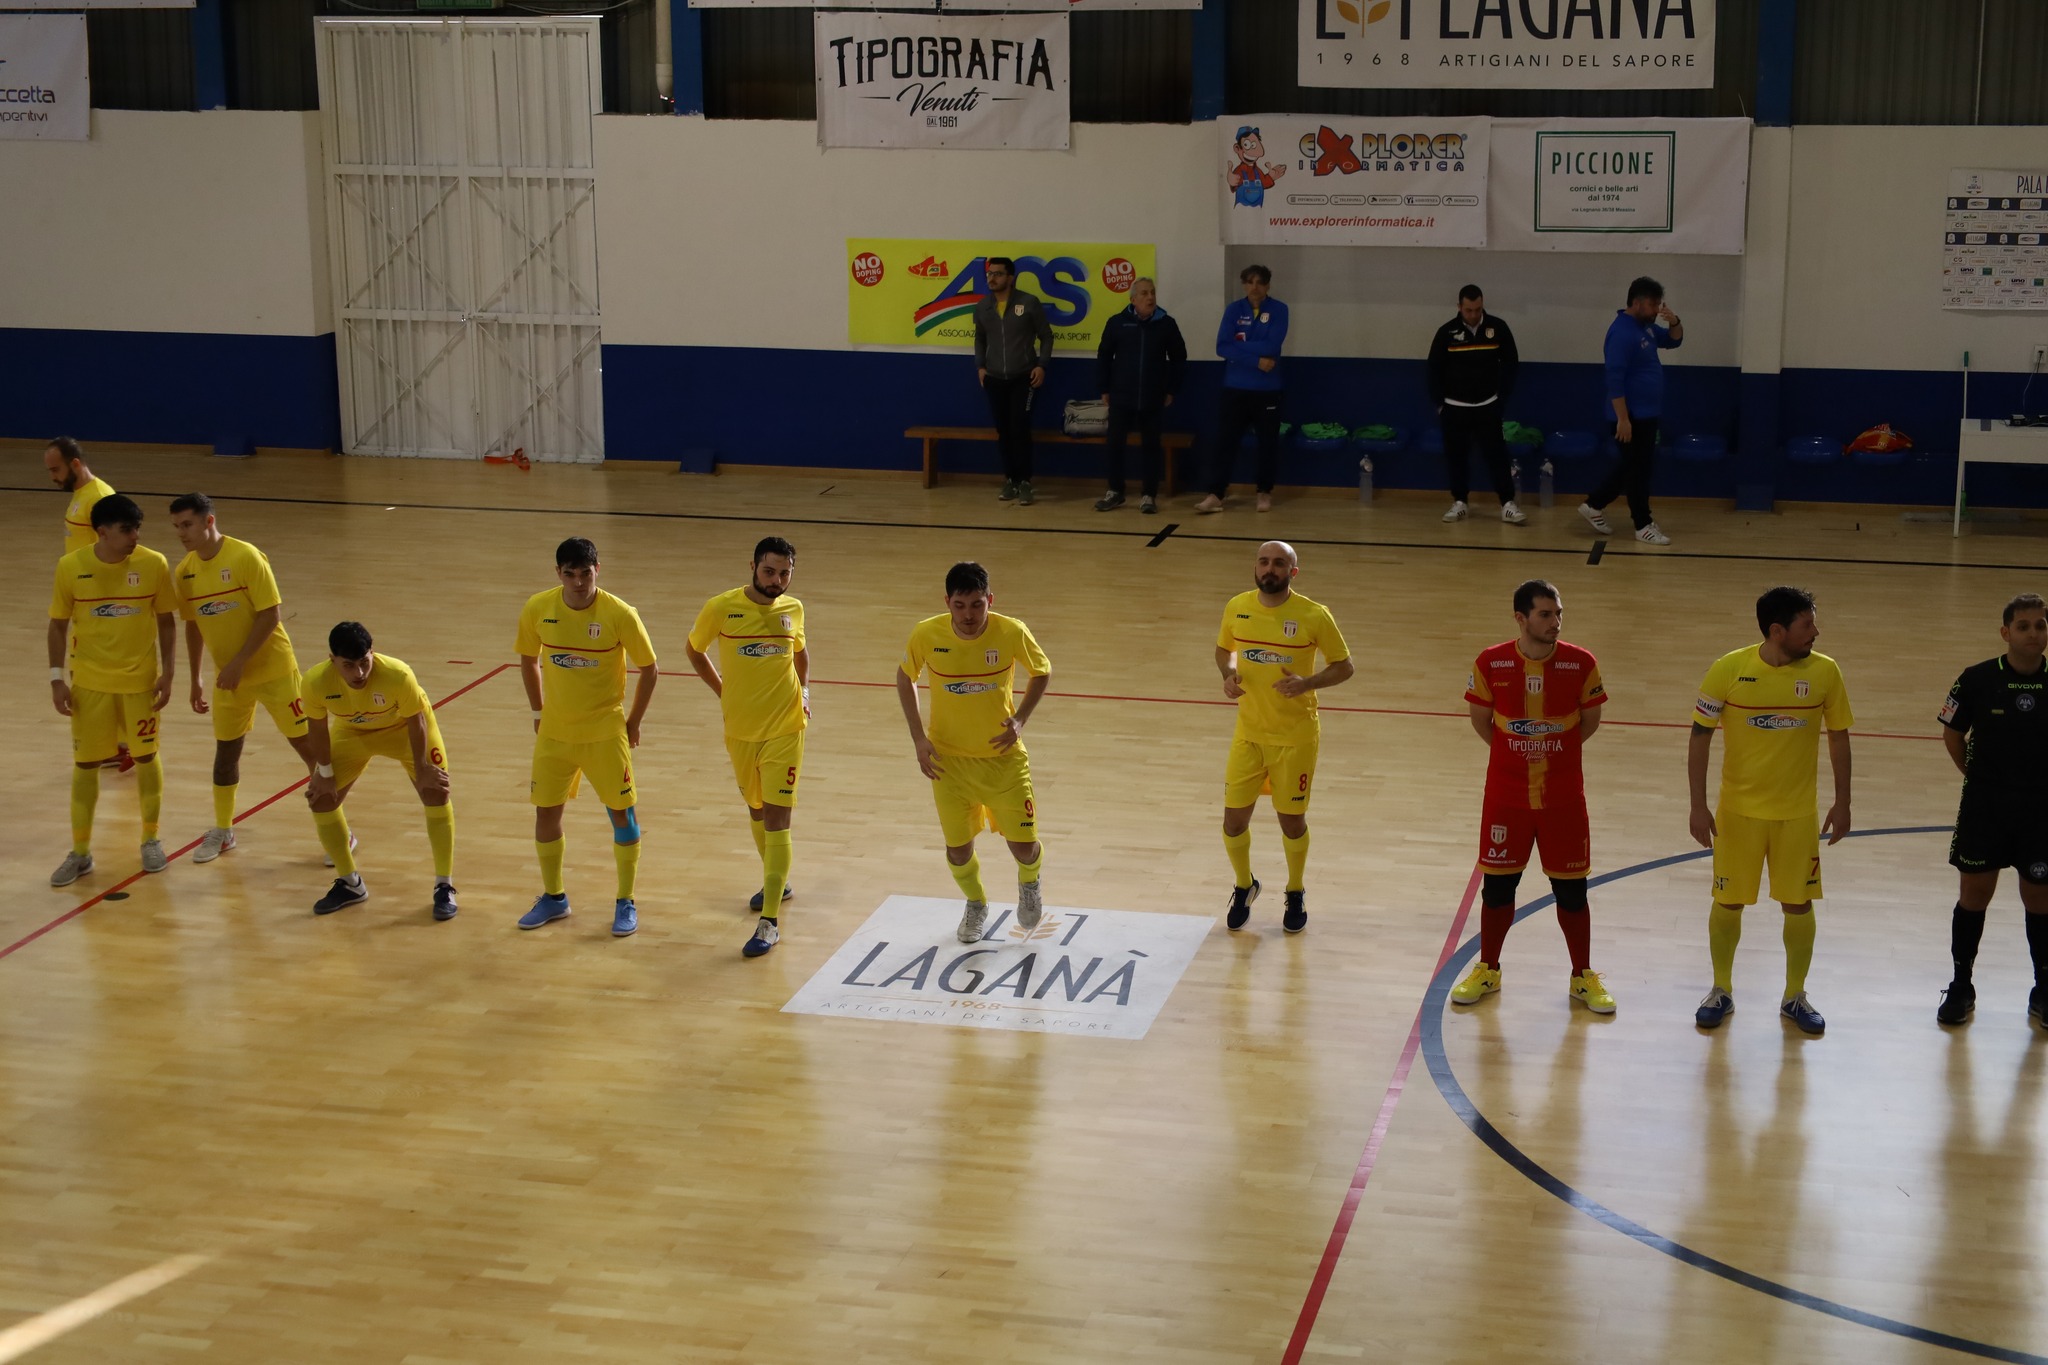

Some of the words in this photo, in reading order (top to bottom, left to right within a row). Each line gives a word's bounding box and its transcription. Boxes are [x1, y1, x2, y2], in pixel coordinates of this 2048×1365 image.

[830, 36, 1055, 91] TIPOGRAFIA
[1439, 53, 1550, 67] ARTIGIANI
[1562, 54, 1600, 67] DEL
[1612, 54, 1696, 68] SAPORE
[896, 81, 989, 117] Venuti
[938, 116, 958, 128] 1961
[1299, 160, 1465, 172] INFORMATICA
[1552, 151, 1654, 174] PICCIONE
[2016, 175, 2042, 194] PALA
[1269, 215, 1435, 229] www.explorerinformatica.it
[854, 256, 881, 271] NO
[1104, 261, 1132, 277] NO
[856, 268, 882, 278] DOPING
[1106, 273, 1133, 284] DOPING
[1067, 333, 1091, 341] SPORT
[1490, 660, 1515, 669] MORGANA
[1554, 661, 1580, 670] MORGANA
[2007, 682, 2043, 690] GIVOVA
[137, 717, 156, 737] 22
[1756, 717, 1801, 727] Cristallina
[1507, 738, 1563, 751] TIPOGRAFIA
[430, 747, 443, 765] 6
[786, 766, 796, 785] 5
[1299, 773, 1308, 791] 8
[1024, 799, 1034, 818] 9
[1811, 856, 1819, 876] 7
[841, 942, 1149, 1006] LAGANÀ
[948, 999, 1002, 1010] 1968
[820, 1001, 947, 1018] ARTIGIANI
[1020, 1017, 1114, 1031] SAPORE
